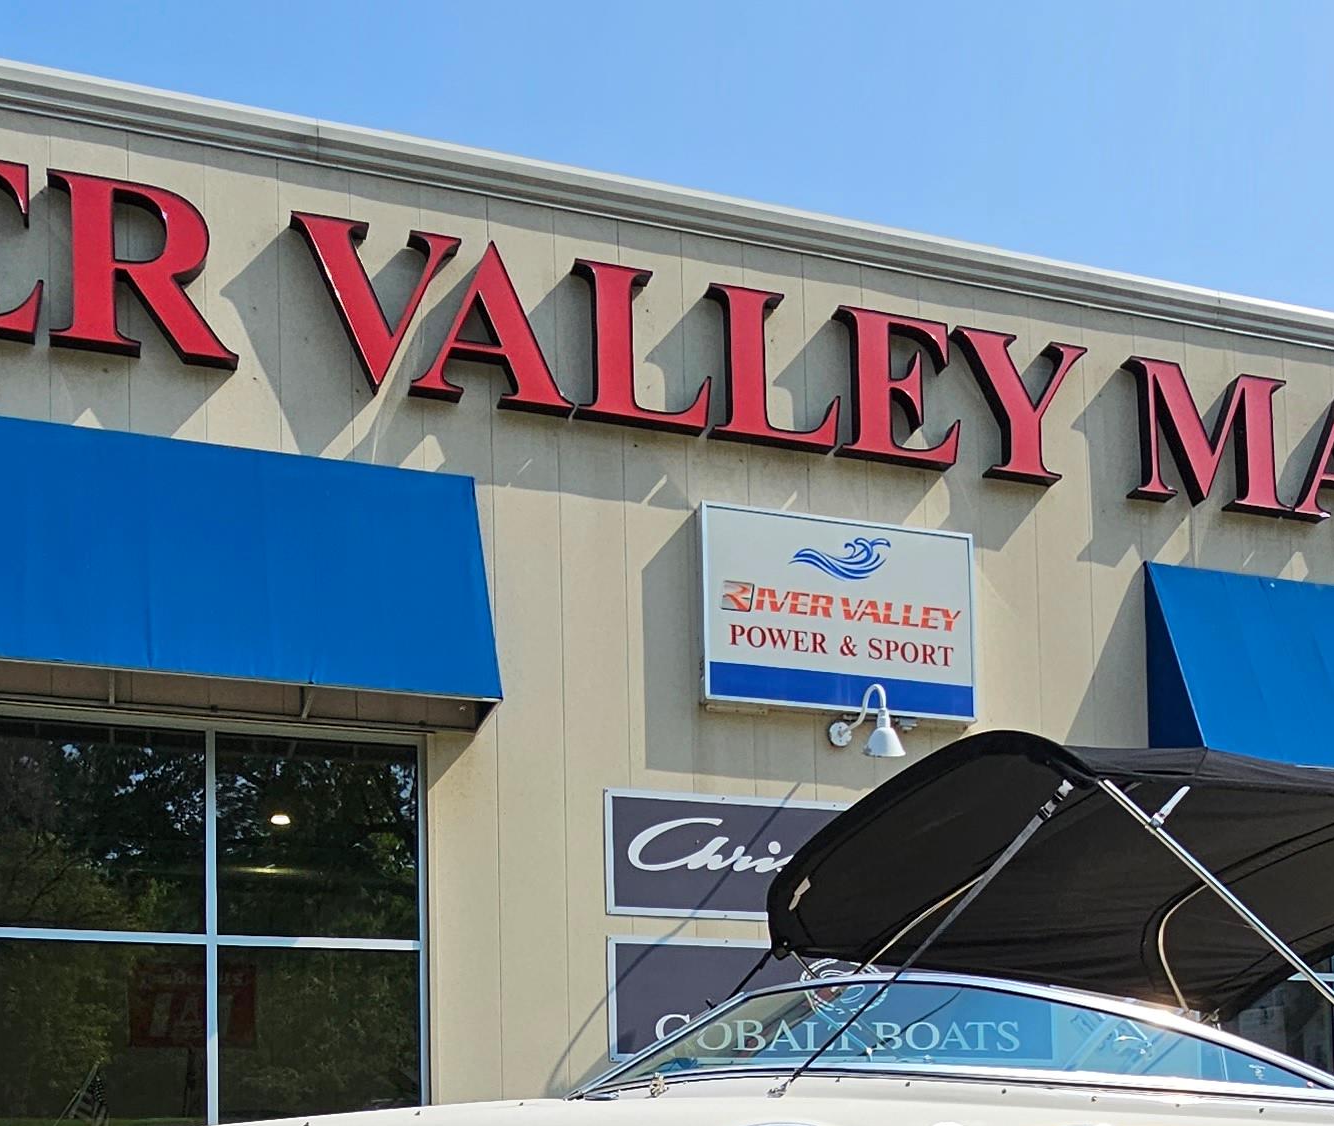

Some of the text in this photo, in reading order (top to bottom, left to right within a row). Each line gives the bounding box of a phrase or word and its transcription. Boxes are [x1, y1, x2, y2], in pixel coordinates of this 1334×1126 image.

[291, 210, 1088, 487] VALLEY
[721, 580, 962, 632] RIVER VALLEY
[729, 624, 954, 667] POWER & SPORT
[871, 1022, 1020, 1052] BOATS
